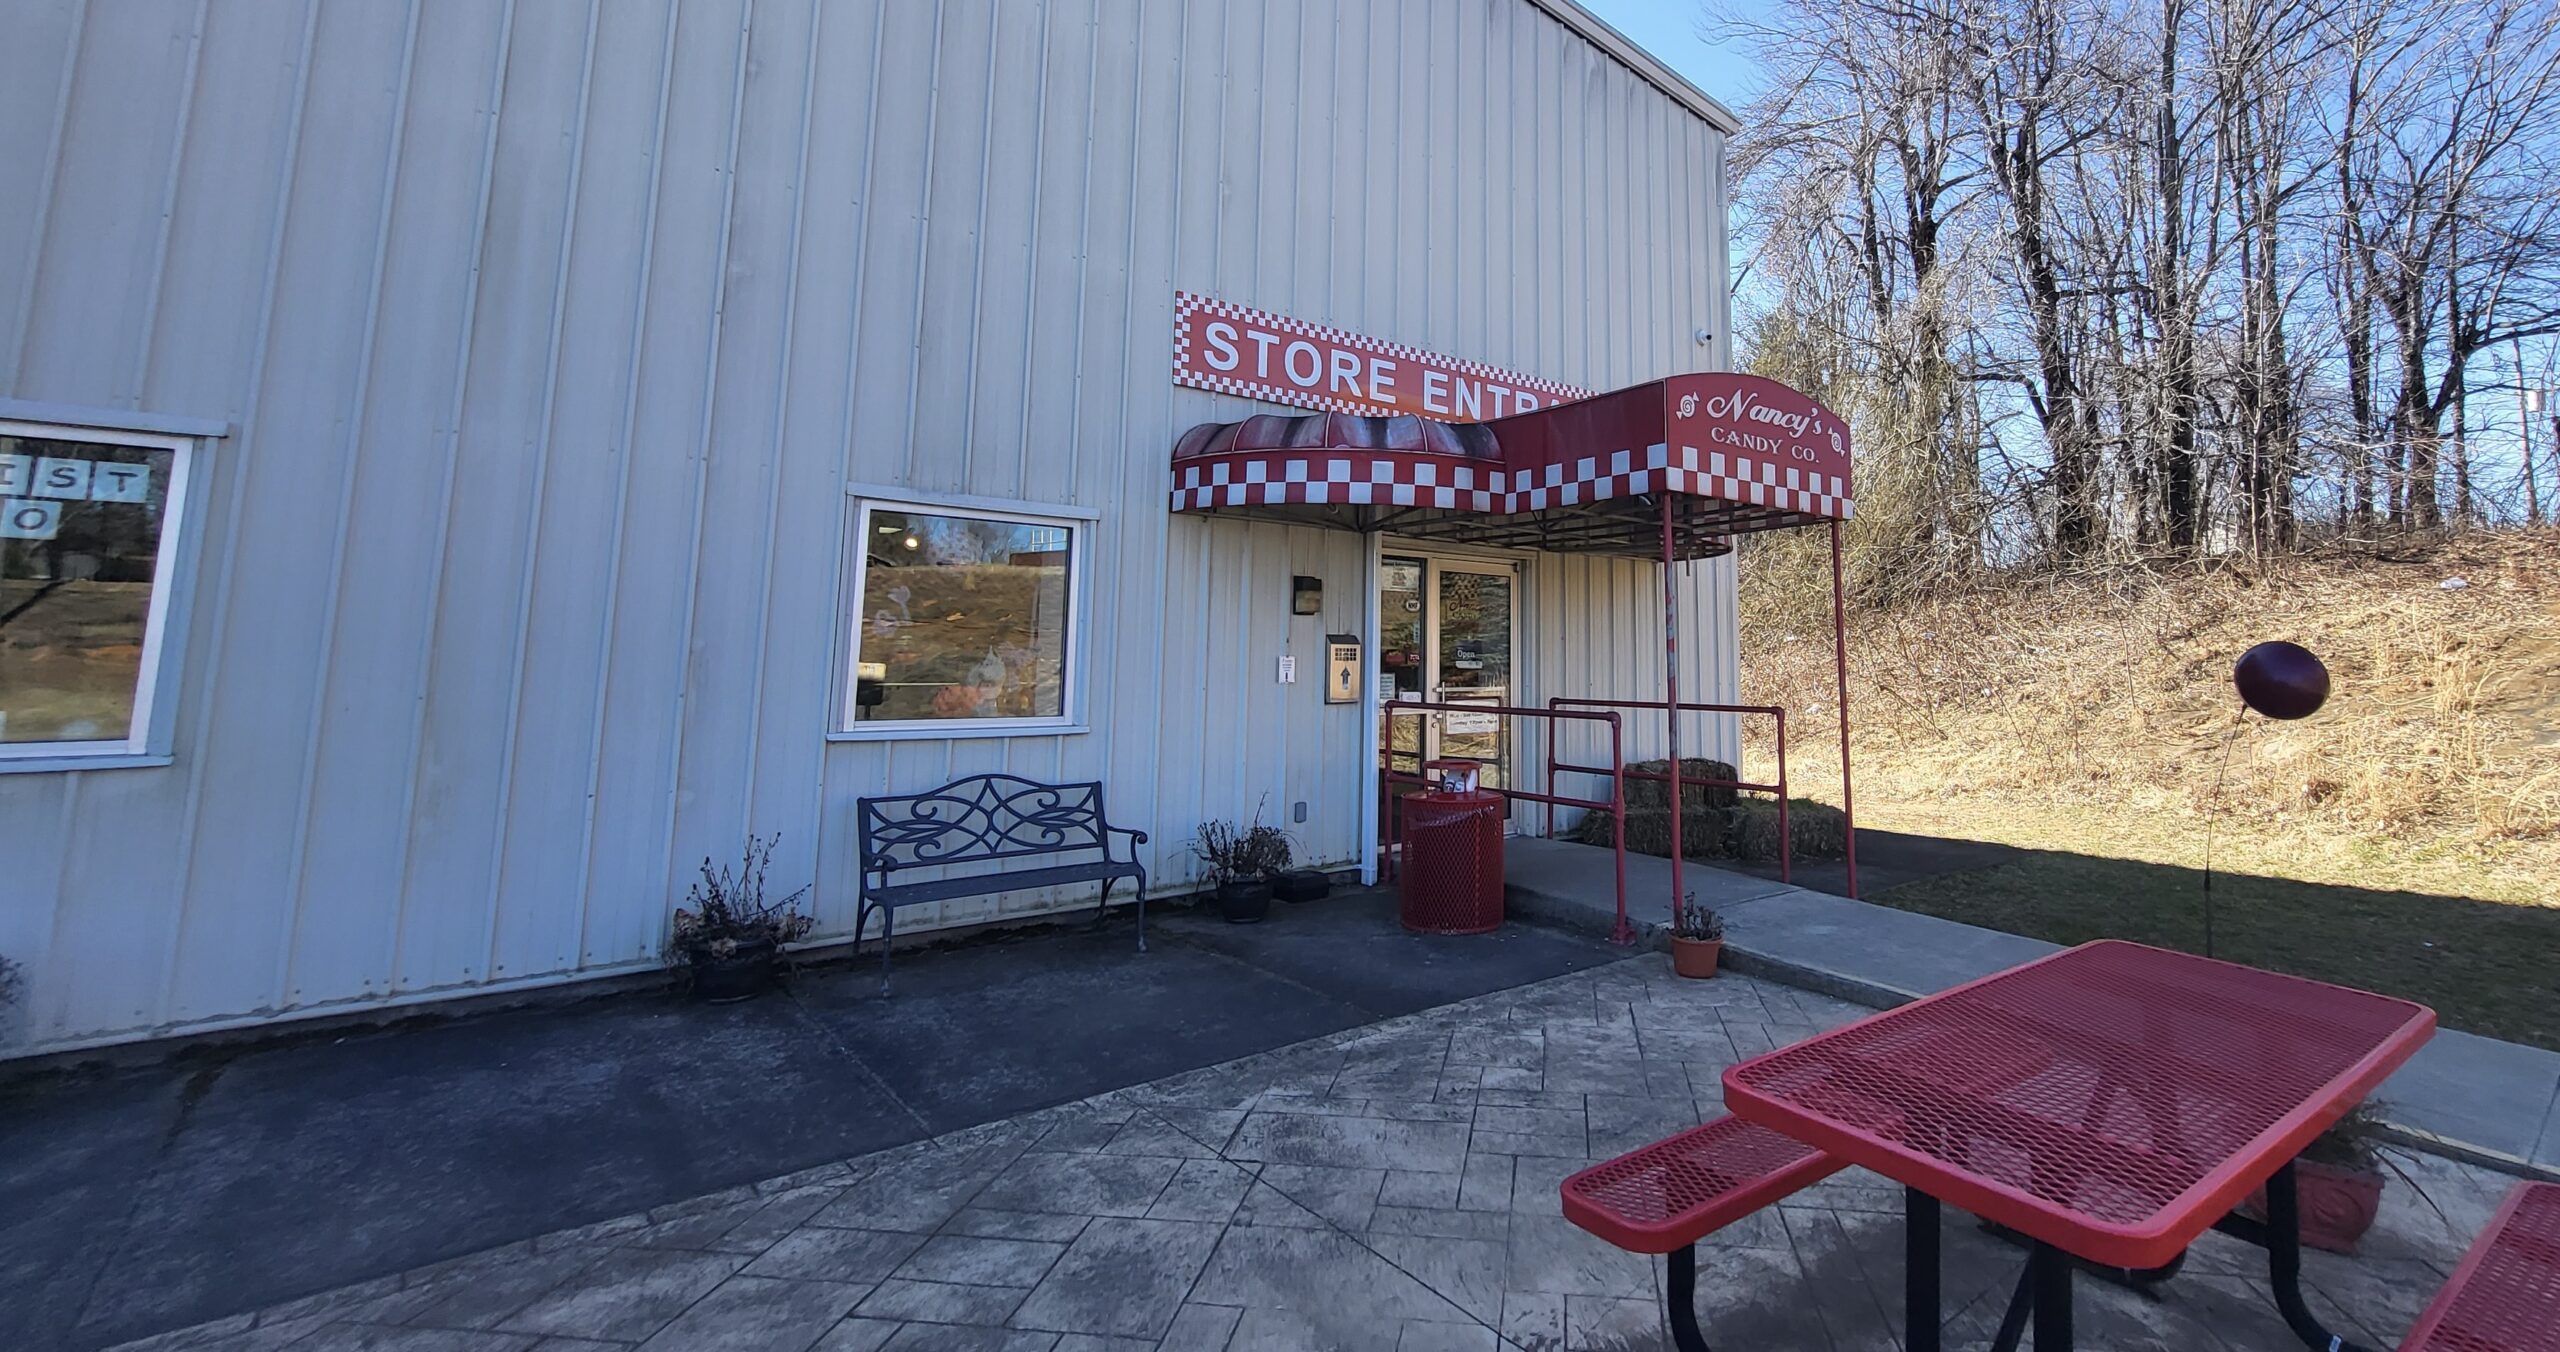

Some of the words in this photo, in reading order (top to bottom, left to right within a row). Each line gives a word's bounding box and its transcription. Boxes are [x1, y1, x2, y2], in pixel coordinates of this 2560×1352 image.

[1203, 322, 1397, 404] STORE
[1423, 370, 1560, 419] ENTR
[1706, 389, 1822, 438] Nancy's
[1711, 427, 1784, 454] CANDY
[1791, 445, 1820, 463] CO.
